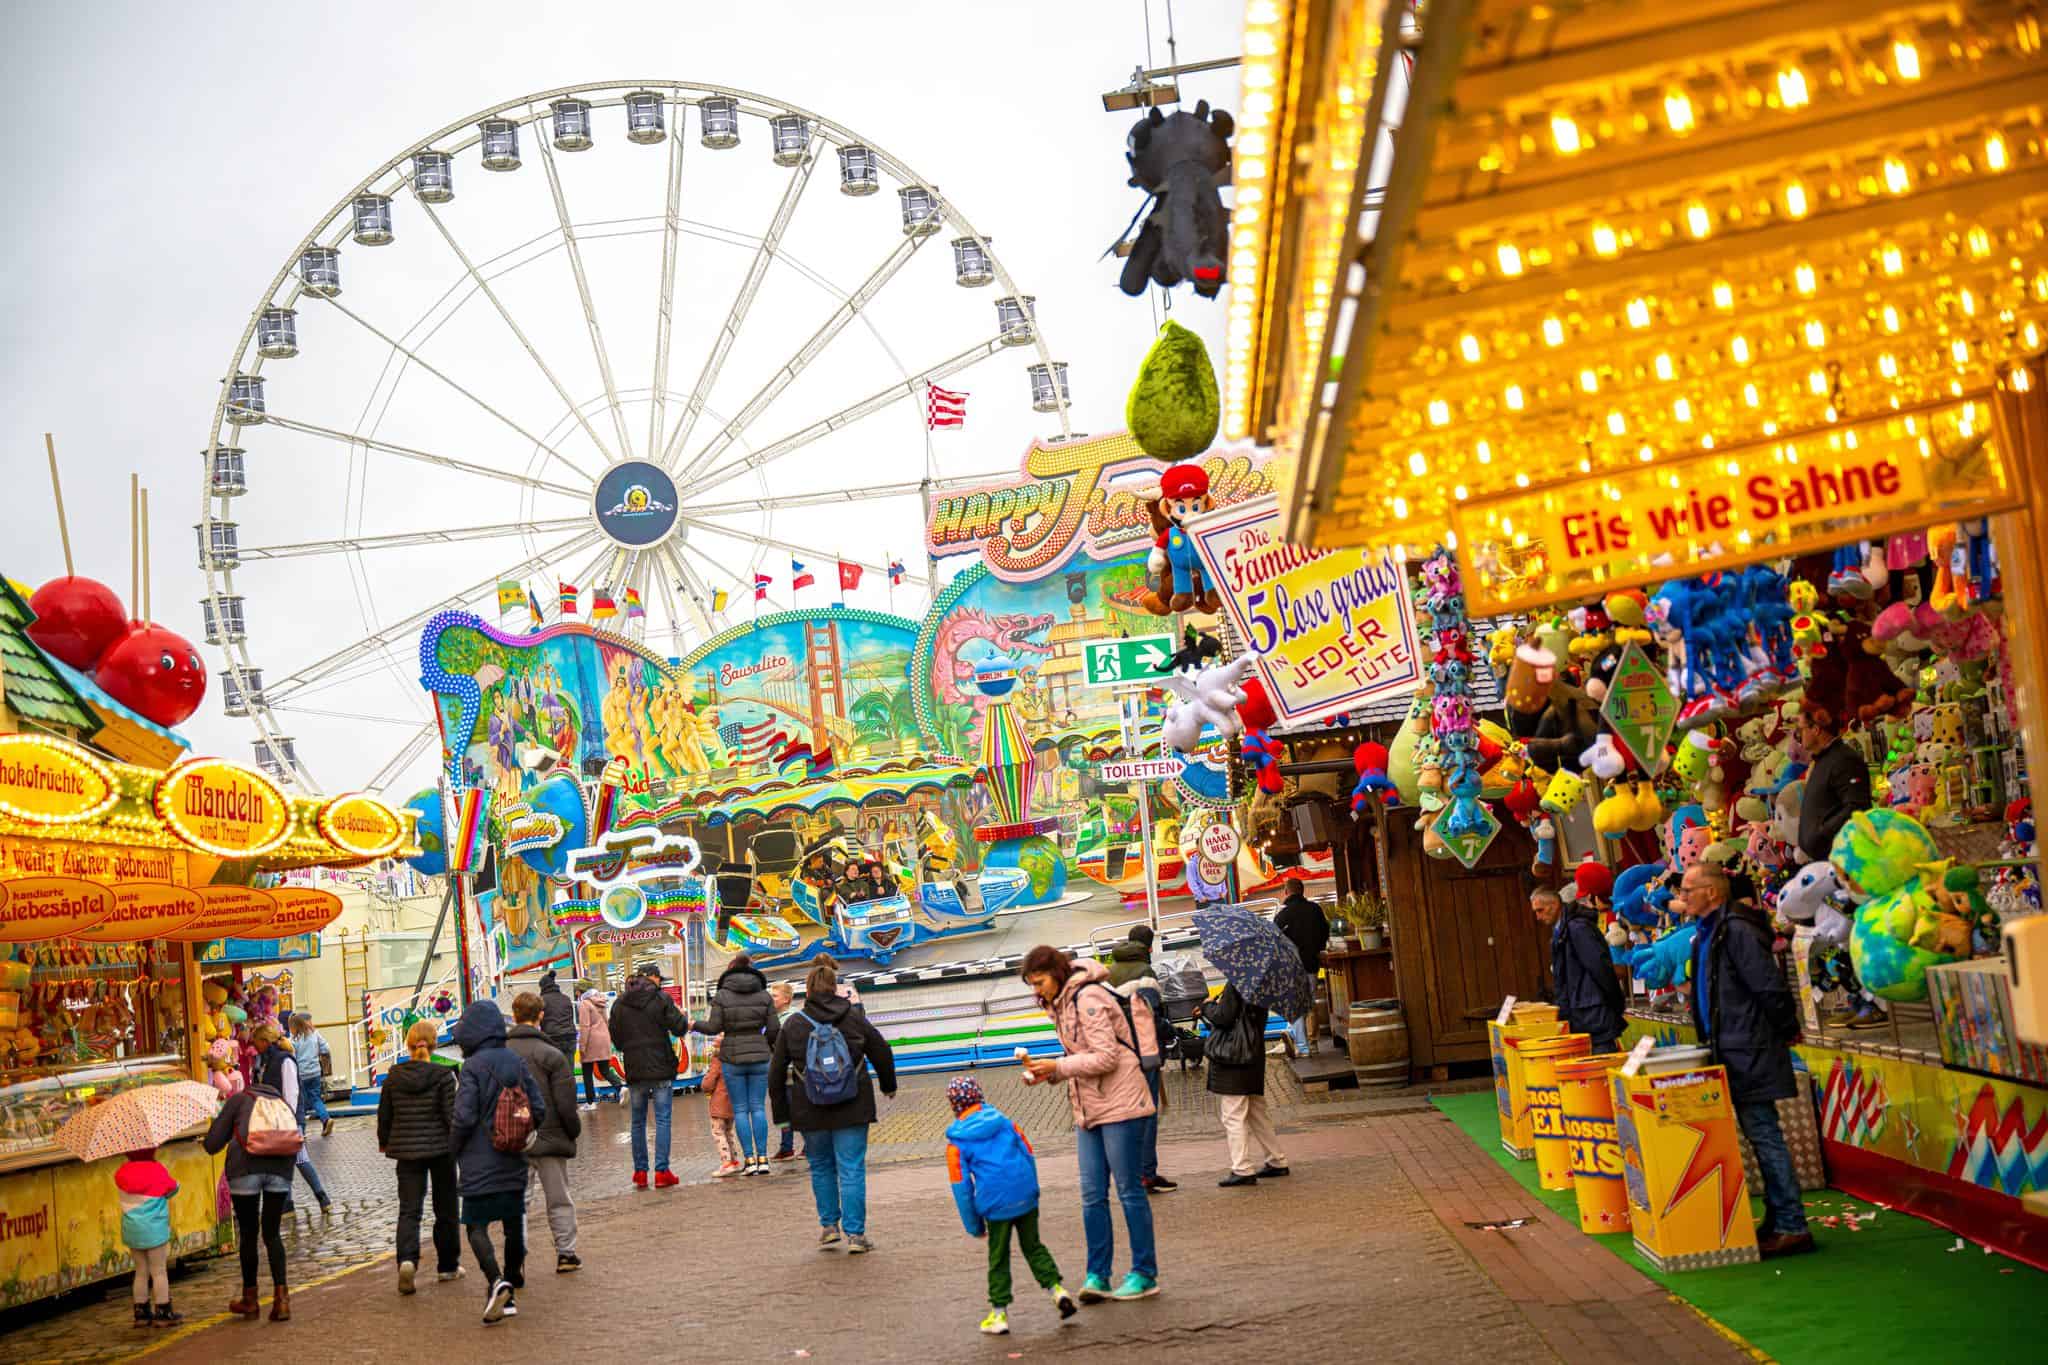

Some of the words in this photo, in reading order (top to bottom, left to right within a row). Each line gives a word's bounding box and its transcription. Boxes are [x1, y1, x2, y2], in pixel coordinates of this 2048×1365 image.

[931, 479, 1070, 549] HAPPY
[1561, 509, 1632, 560] Eis
[1647, 489, 1731, 541] wie
[1746, 457, 1902, 522] Sahne
[1239, 529, 1271, 553] Die
[1247, 591, 1278, 655] 5
[1275, 583, 1331, 643] Lose
[1270, 656, 1290, 673] IN
[1293, 618, 1388, 689] JEDER
[1345, 643, 1410, 687] TÜTE
[720, 655, 787, 687] Sausalito
[0, 758, 85, 796] hokofrüchte
[613, 754, 661, 795] Lid
[1104, 760, 1176, 780] TOILETTEN
[185, 774, 264, 824] Mandeln
[1205, 833, 1233, 847] HAAKE
[1210, 843, 1232, 855] BECK
[13, 888, 65, 901] kandierte
[117, 893, 140, 902] unte
[206, 894, 252, 905] hewkerne
[102, 899, 196, 924] uckerwatte
[201, 903, 272, 918] nblumenkerne
[267, 906, 331, 925] andeln
[1531, 1107, 1566, 1136] EI
[1569, 1140, 1625, 1176] EIS
